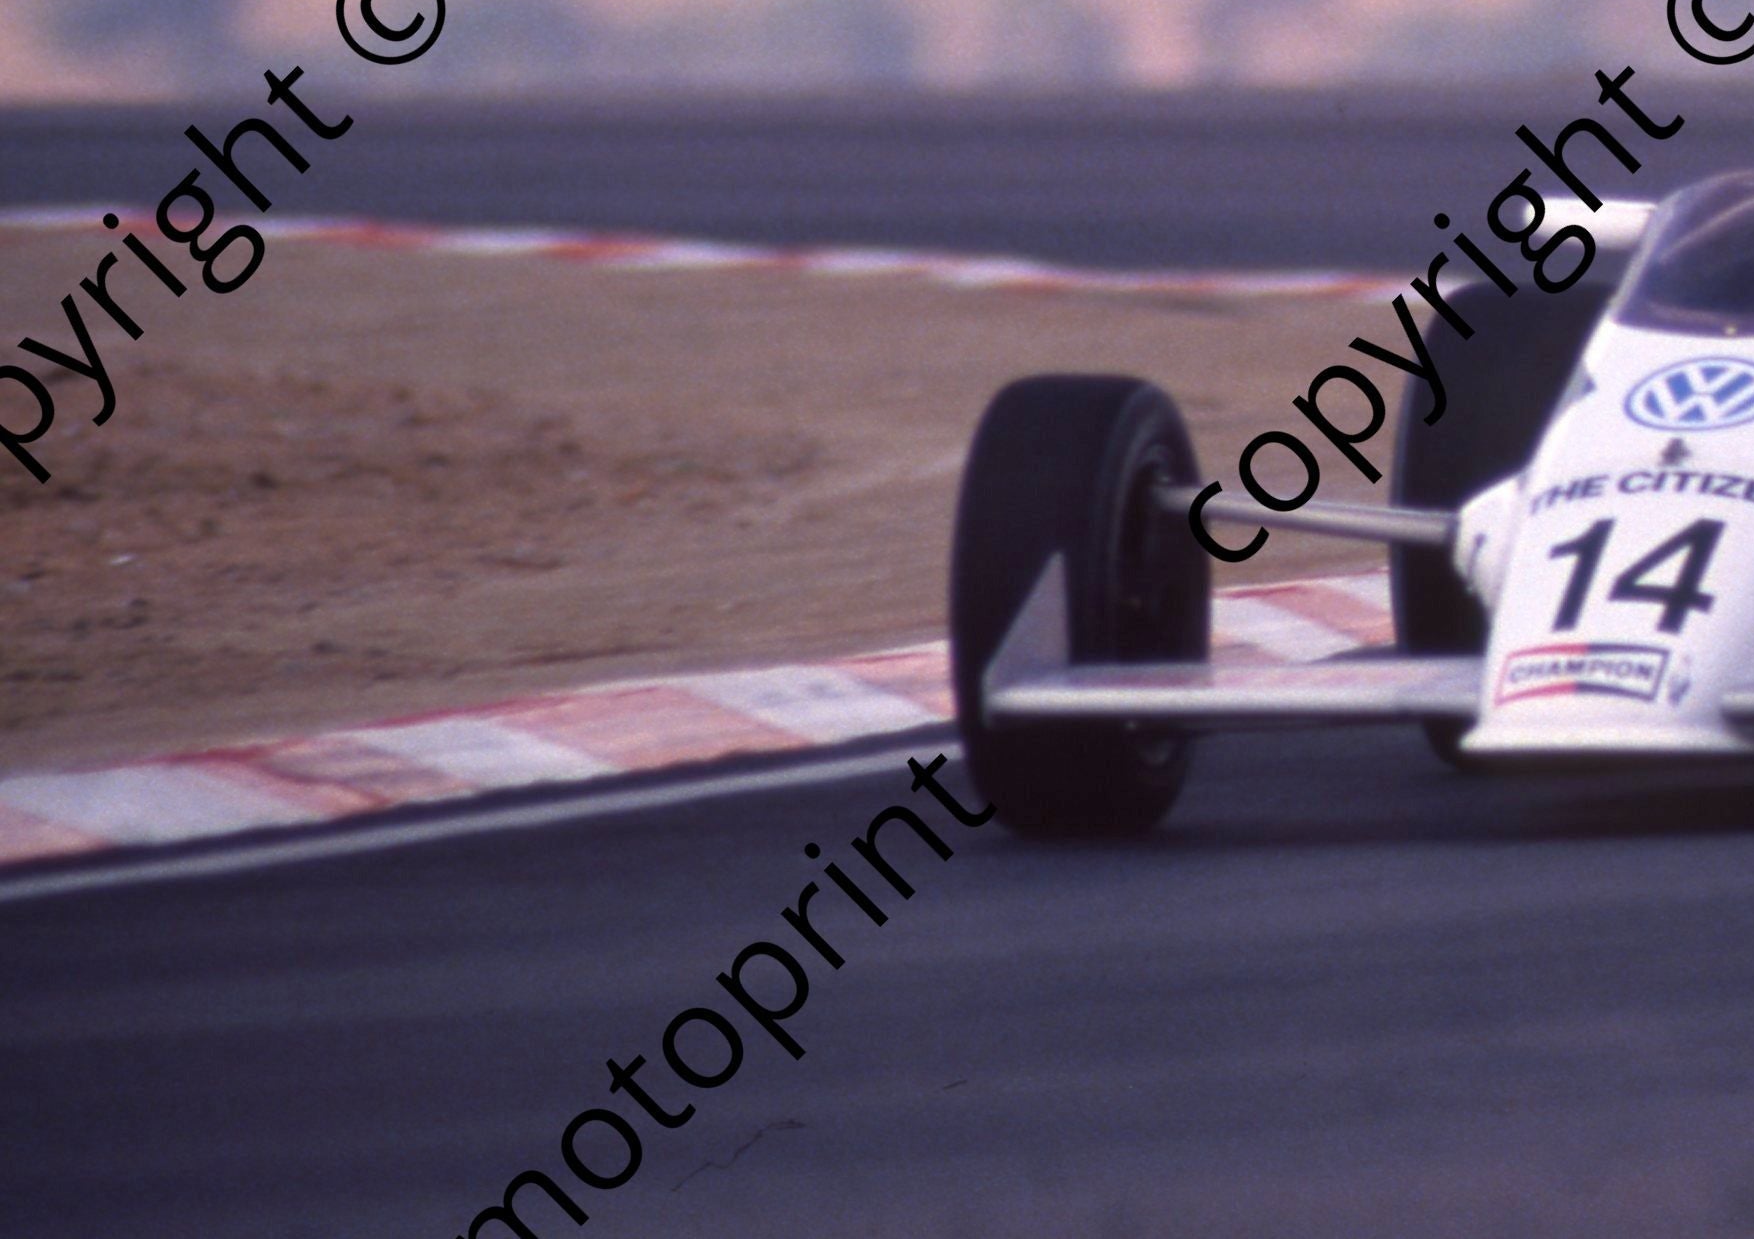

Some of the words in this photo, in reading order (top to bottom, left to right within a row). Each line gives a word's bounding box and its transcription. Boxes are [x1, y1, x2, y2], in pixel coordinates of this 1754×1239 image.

[1530, 474, 1610, 515] THE
[1548, 517, 1727, 636] 14
[1509, 659, 1655, 684] CHAMPION
